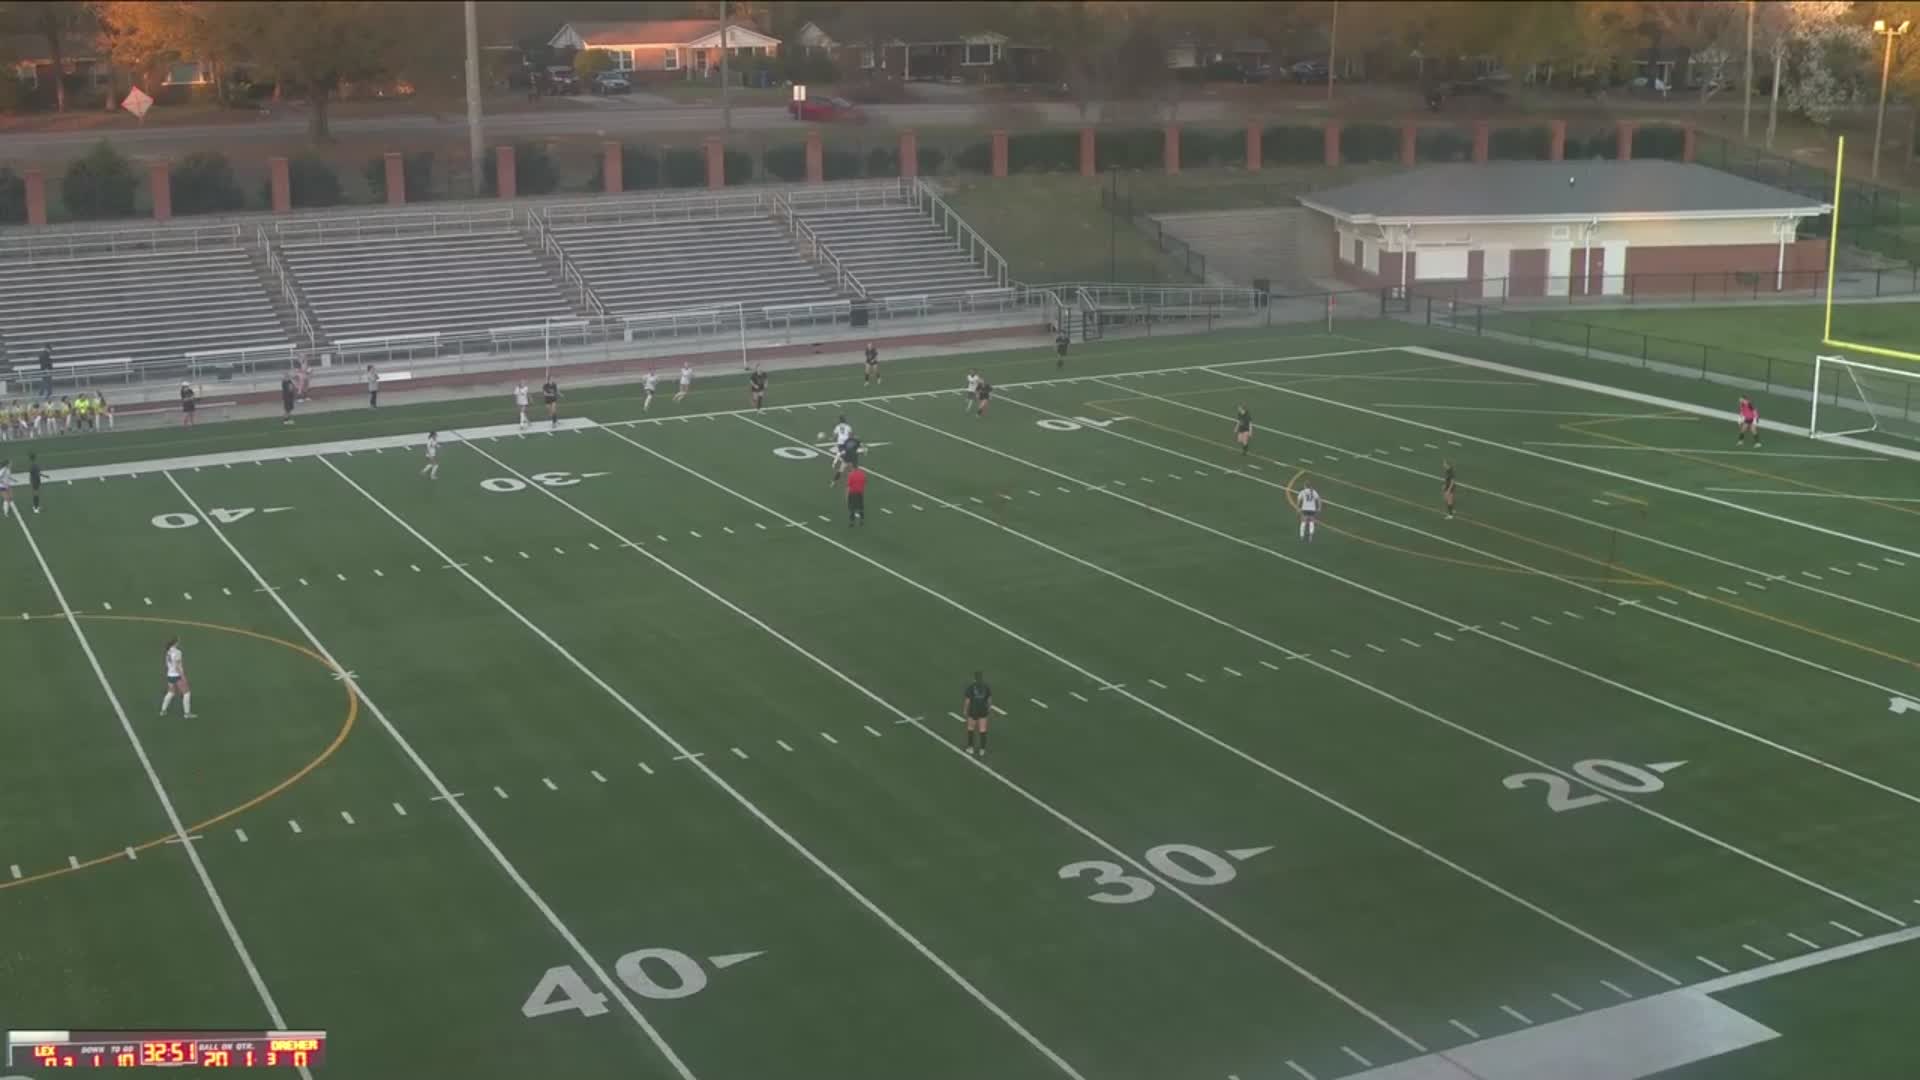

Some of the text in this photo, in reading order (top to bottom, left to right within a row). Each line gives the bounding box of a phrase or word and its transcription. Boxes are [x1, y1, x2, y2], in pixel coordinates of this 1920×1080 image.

[480, 471, 581, 492] 30
[151, 506, 255, 529] 40
[1502, 759, 1665, 812] 20
[1058, 843, 1238, 904] 30
[522, 947, 707, 1018] 40
